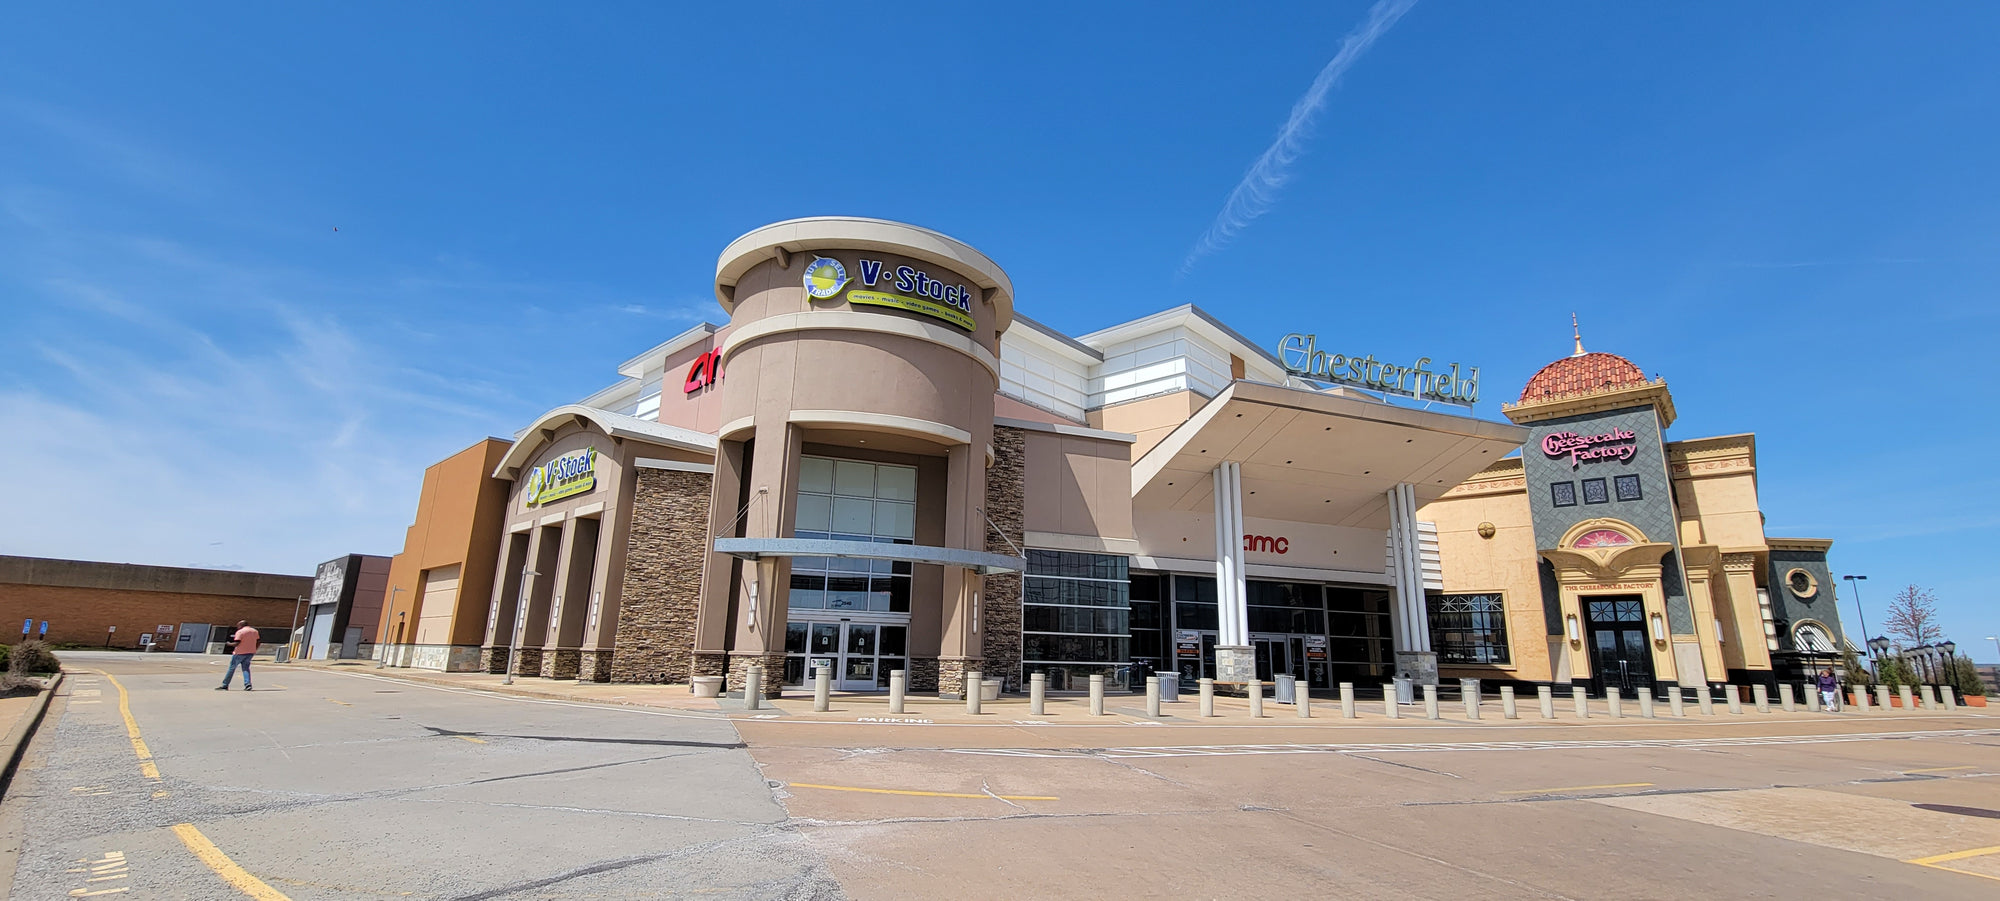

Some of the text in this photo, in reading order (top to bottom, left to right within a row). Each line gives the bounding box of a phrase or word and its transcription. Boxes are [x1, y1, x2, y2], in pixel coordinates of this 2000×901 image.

[805, 261, 819, 279] BUY
[829, 260, 845, 278] SELL
[811, 286, 838, 296] TRADE
[881, 296, 899, 304] music
[905, 301, 921, 309] video
[922, 305, 940, 314] games
[1278, 333, 1480, 402] Chesterfield
[1541, 427, 1635, 455] Cheesecake
[1561, 444, 1637, 467] Factory
